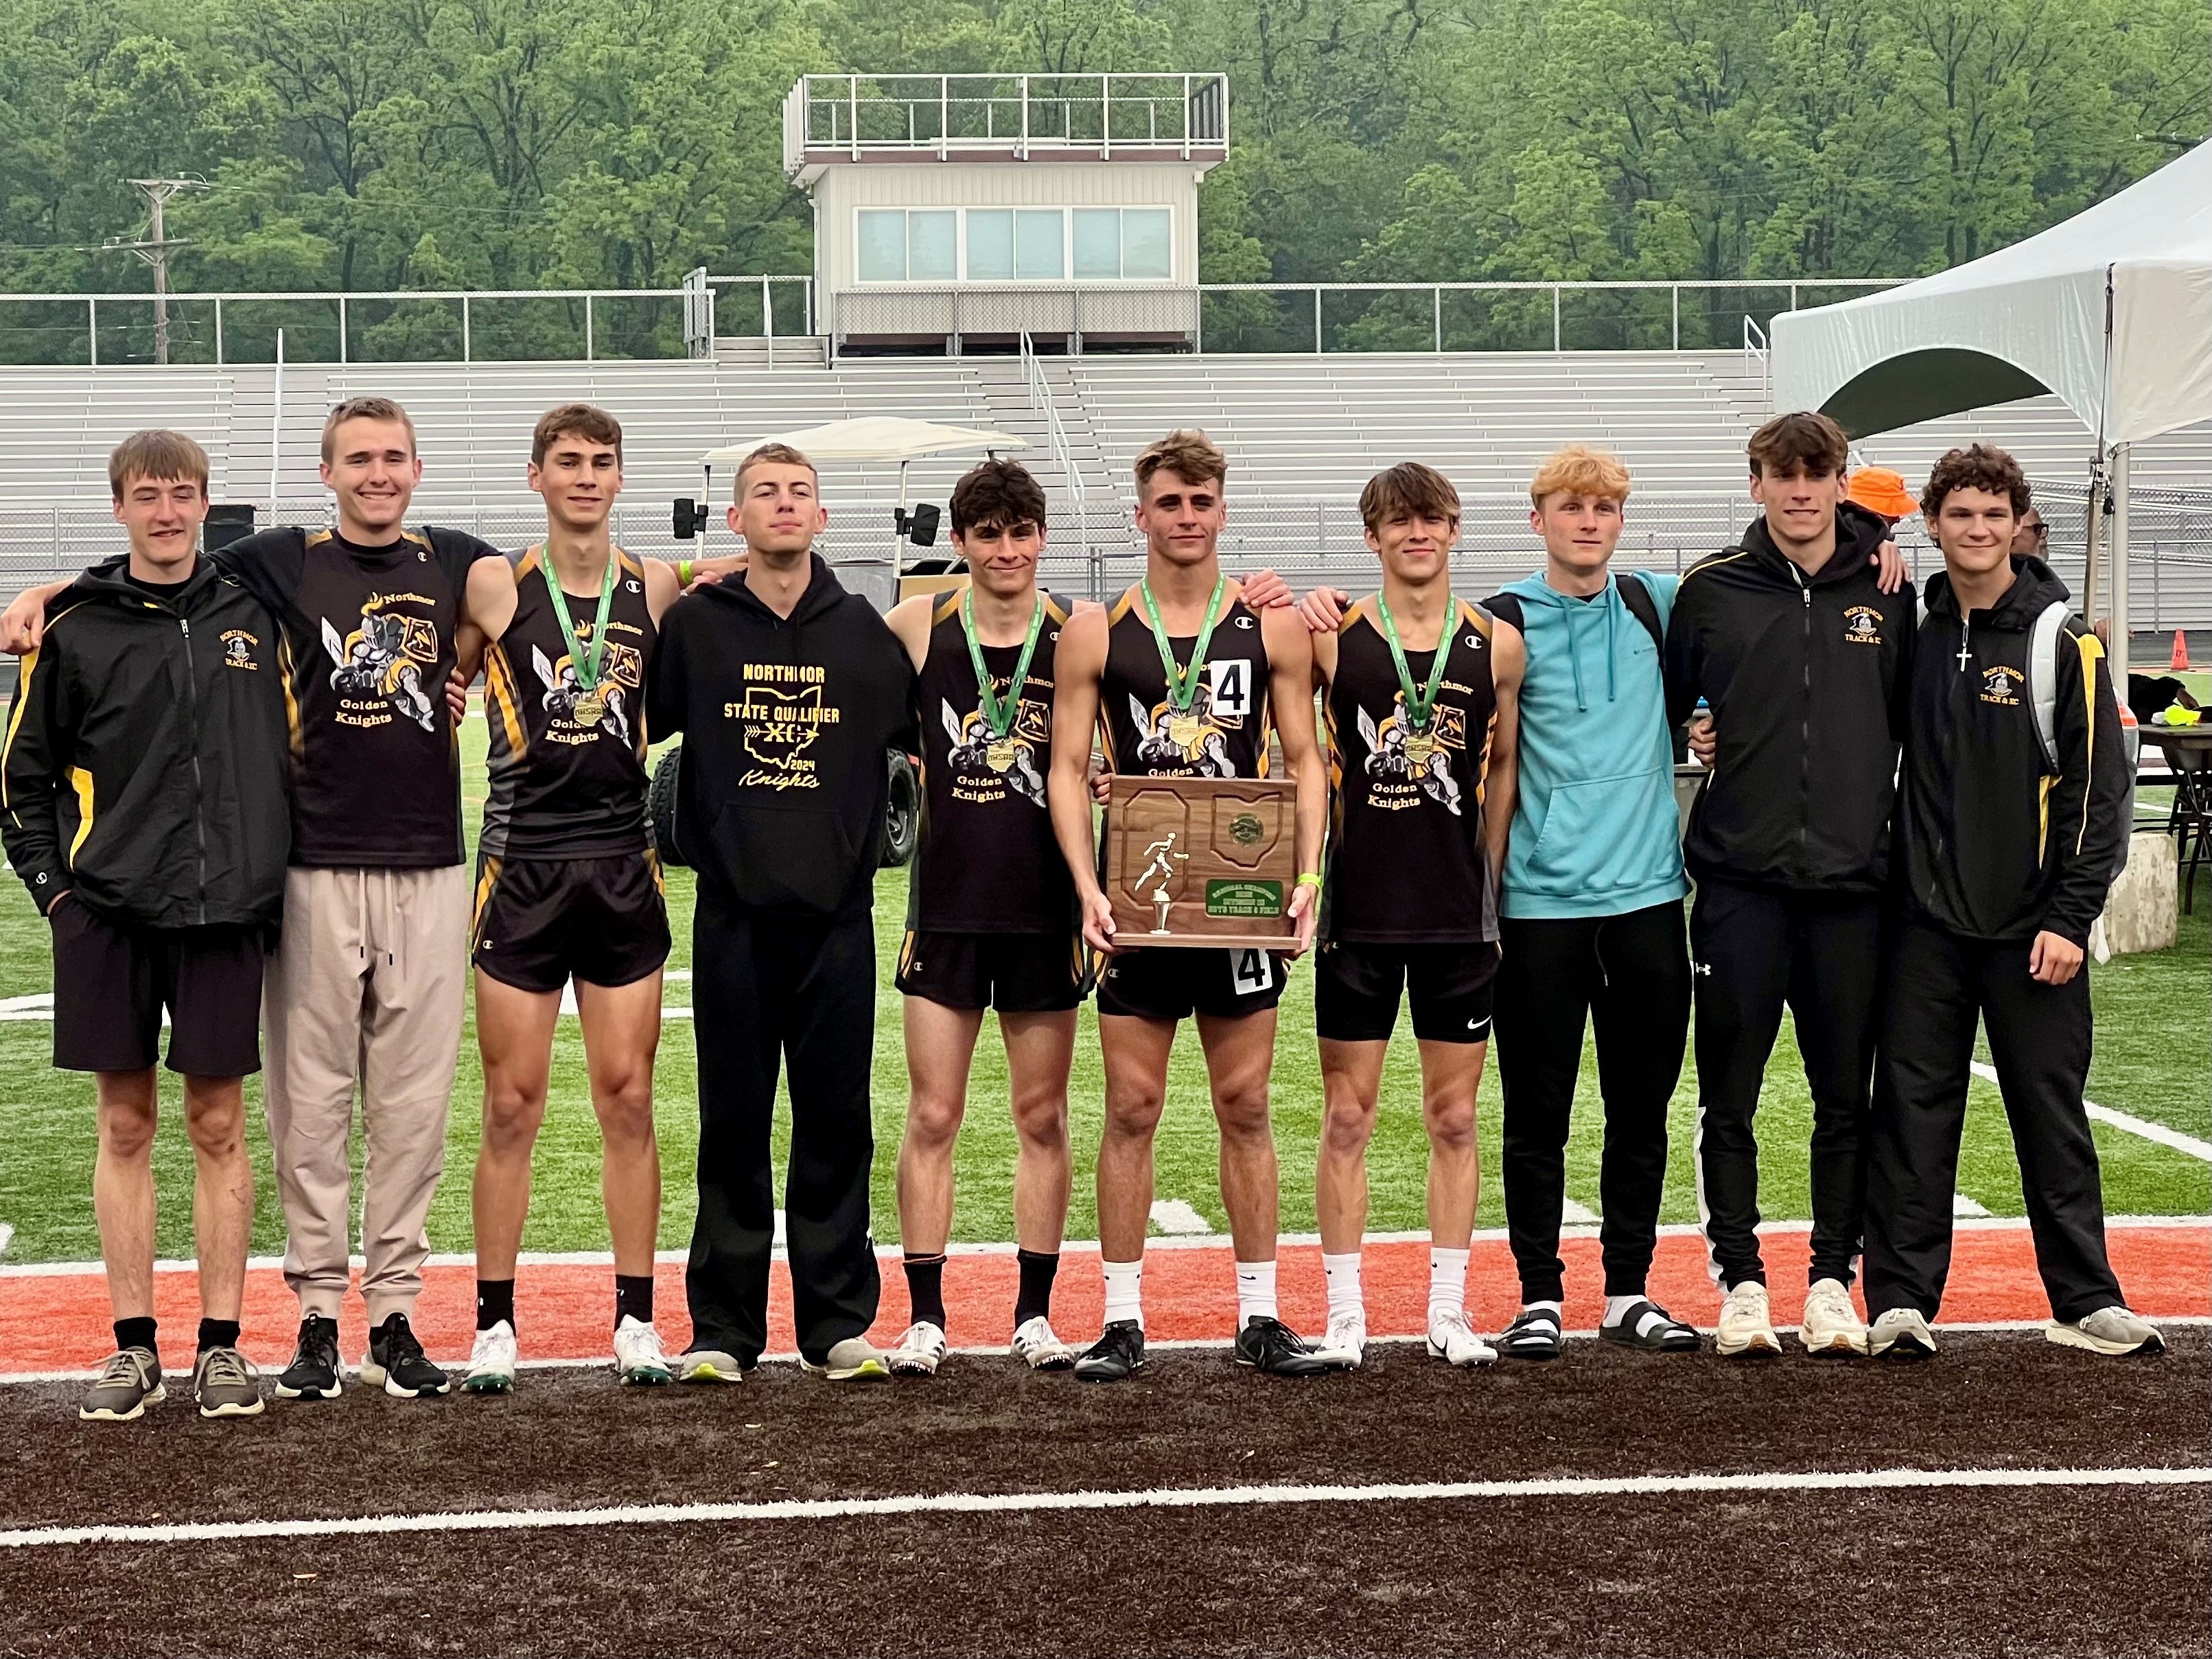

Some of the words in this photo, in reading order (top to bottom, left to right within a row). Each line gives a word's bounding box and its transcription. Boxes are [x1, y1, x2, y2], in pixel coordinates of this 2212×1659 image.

[384, 592, 436, 606] Northmor
[591, 621, 643, 636] rthmor
[1218, 664, 1244, 710] 4
[1417, 680, 1474, 695] Nthmor
[340, 699, 388, 710] Golden
[724, 703, 768, 720] STATE
[335, 711, 392, 728] Knights
[551, 719, 585, 728] Gold
[545, 730, 599, 745] Knights
[791, 759, 815, 772] 2024
[738, 769, 819, 791] Knights
[957, 776, 1002, 787] Golden
[1373, 782, 1417, 793] Golden
[951, 787, 1005, 803] Knights
[1367, 794, 1421, 810] Knights
[1237, 949, 1266, 987] 4
